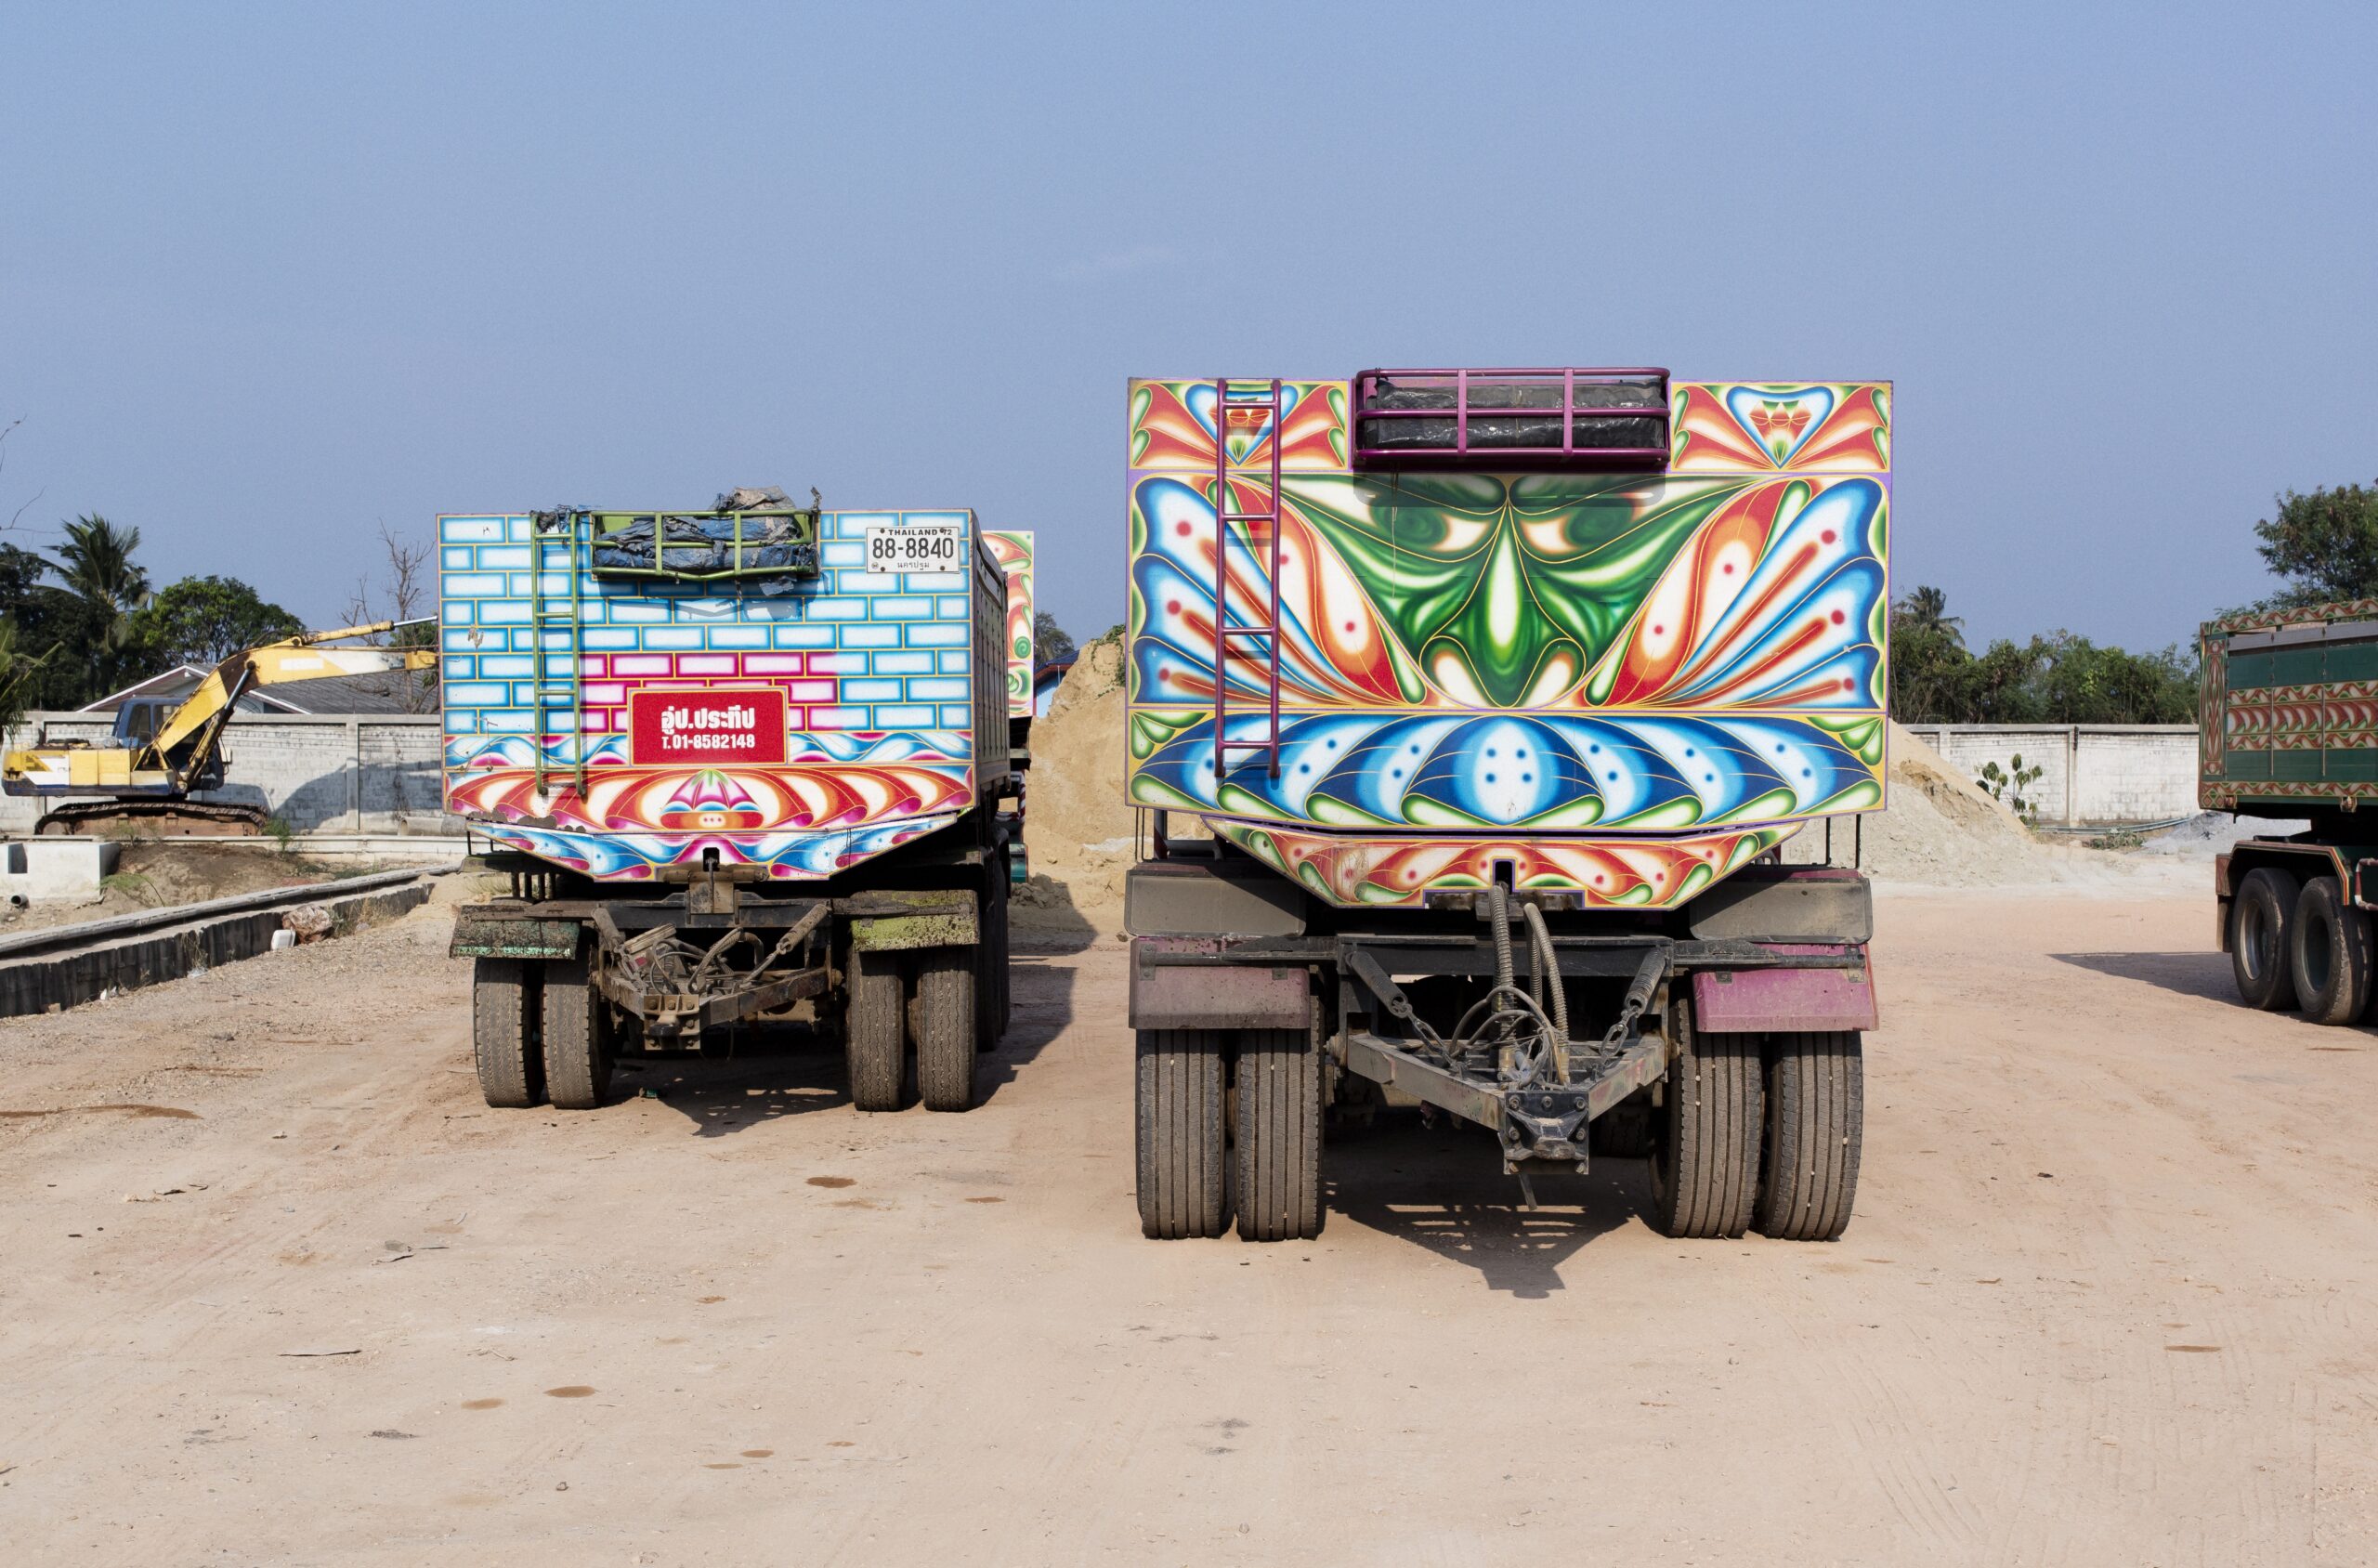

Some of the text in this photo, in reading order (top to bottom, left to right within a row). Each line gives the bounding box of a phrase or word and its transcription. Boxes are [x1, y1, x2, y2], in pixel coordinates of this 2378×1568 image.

[872, 537, 954, 558] 88-8840
[897, 560, 930, 570] นครปฐม
